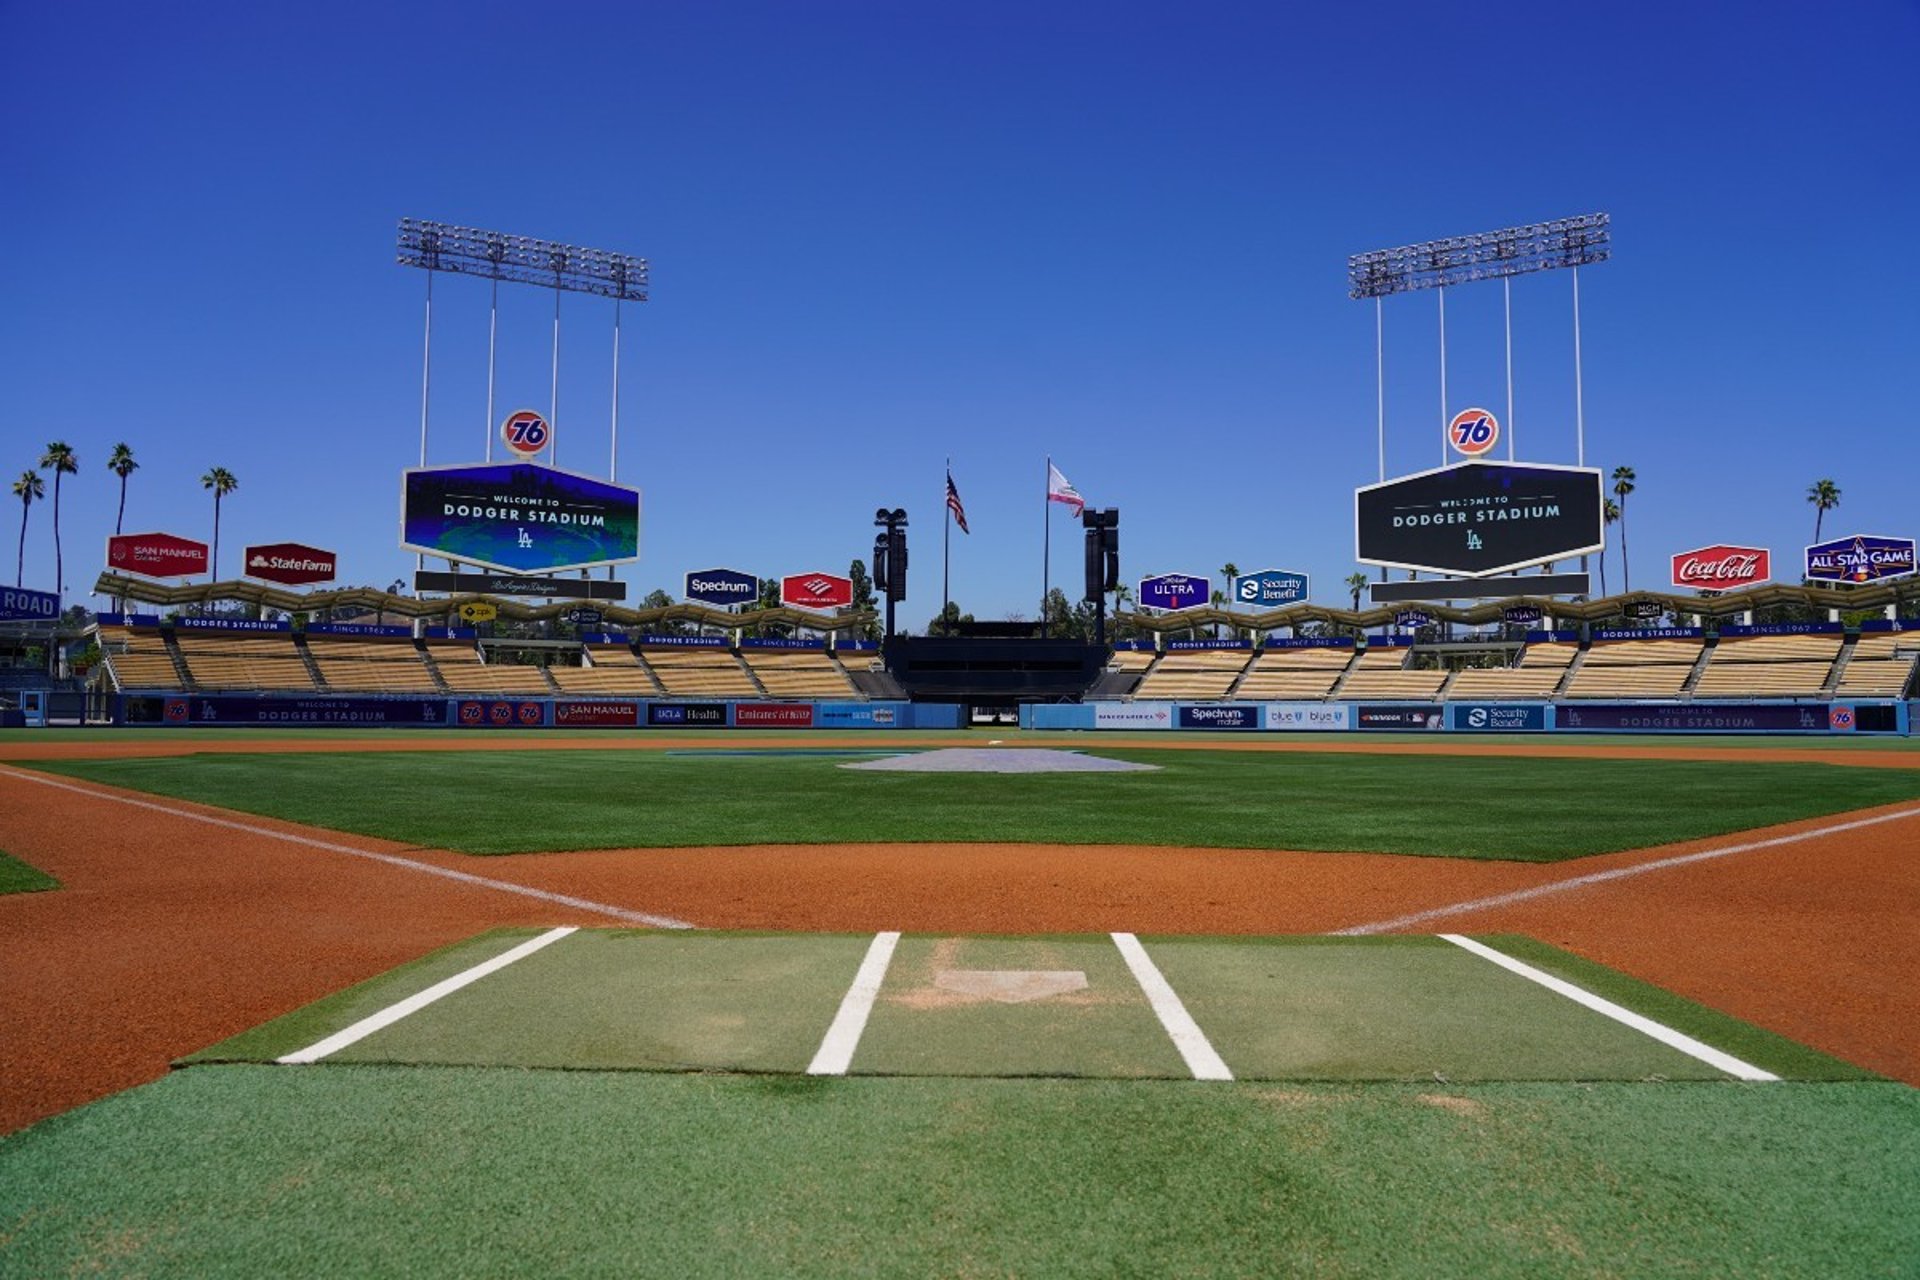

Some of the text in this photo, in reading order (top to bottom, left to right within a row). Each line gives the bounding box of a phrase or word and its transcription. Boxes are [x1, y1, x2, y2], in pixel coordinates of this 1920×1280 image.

[510, 420, 546, 444] 76
[1457, 416, 1491, 444] 76
[494, 495, 542, 505] WELCOME
[1495, 496, 1508, 504] TO
[444, 504, 605, 527] DODGER STADIUM
[1393, 505, 1560, 527] DODGER STADIUM
[518, 528, 533, 548] LA
[1467, 529, 1482, 549] LA
[134, 546, 205, 559] SAN MANUEL
[1870, 550, 1912, 563] GAME
[691, 579, 749, 593] Spectrum
[1262, 579, 1302, 589] Security
[1154, 585, 1195, 595] ULTRA
[1263, 589, 1298, 599] Benefit
[4, 591, 54, 615] ROAD
[185, 618, 278, 630] DODGER STADIUM
[1602, 629, 1692, 638] DODGER STADIUM
[169, 704, 186, 715] 76
[463, 705, 479, 718] 76
[493, 705, 510, 718] 76
[522, 705, 537, 718] 76
[570, 706, 634, 715] SAN MANUEL
[657, 710, 681, 719] UCLA
[687, 709, 720, 720] Health
[1192, 709, 1242, 719] Spectrum
[1491, 709, 1528, 718] Security
[258, 711, 385, 721] DODGER STADIUM
[1272, 712, 1292, 721] blue
[1310, 712, 1331, 721] blue
[1832, 711, 1850, 724] 76
[1491, 718, 1523, 727] Benefit
[1620, 717, 1755, 727] DODGER STADIUM
